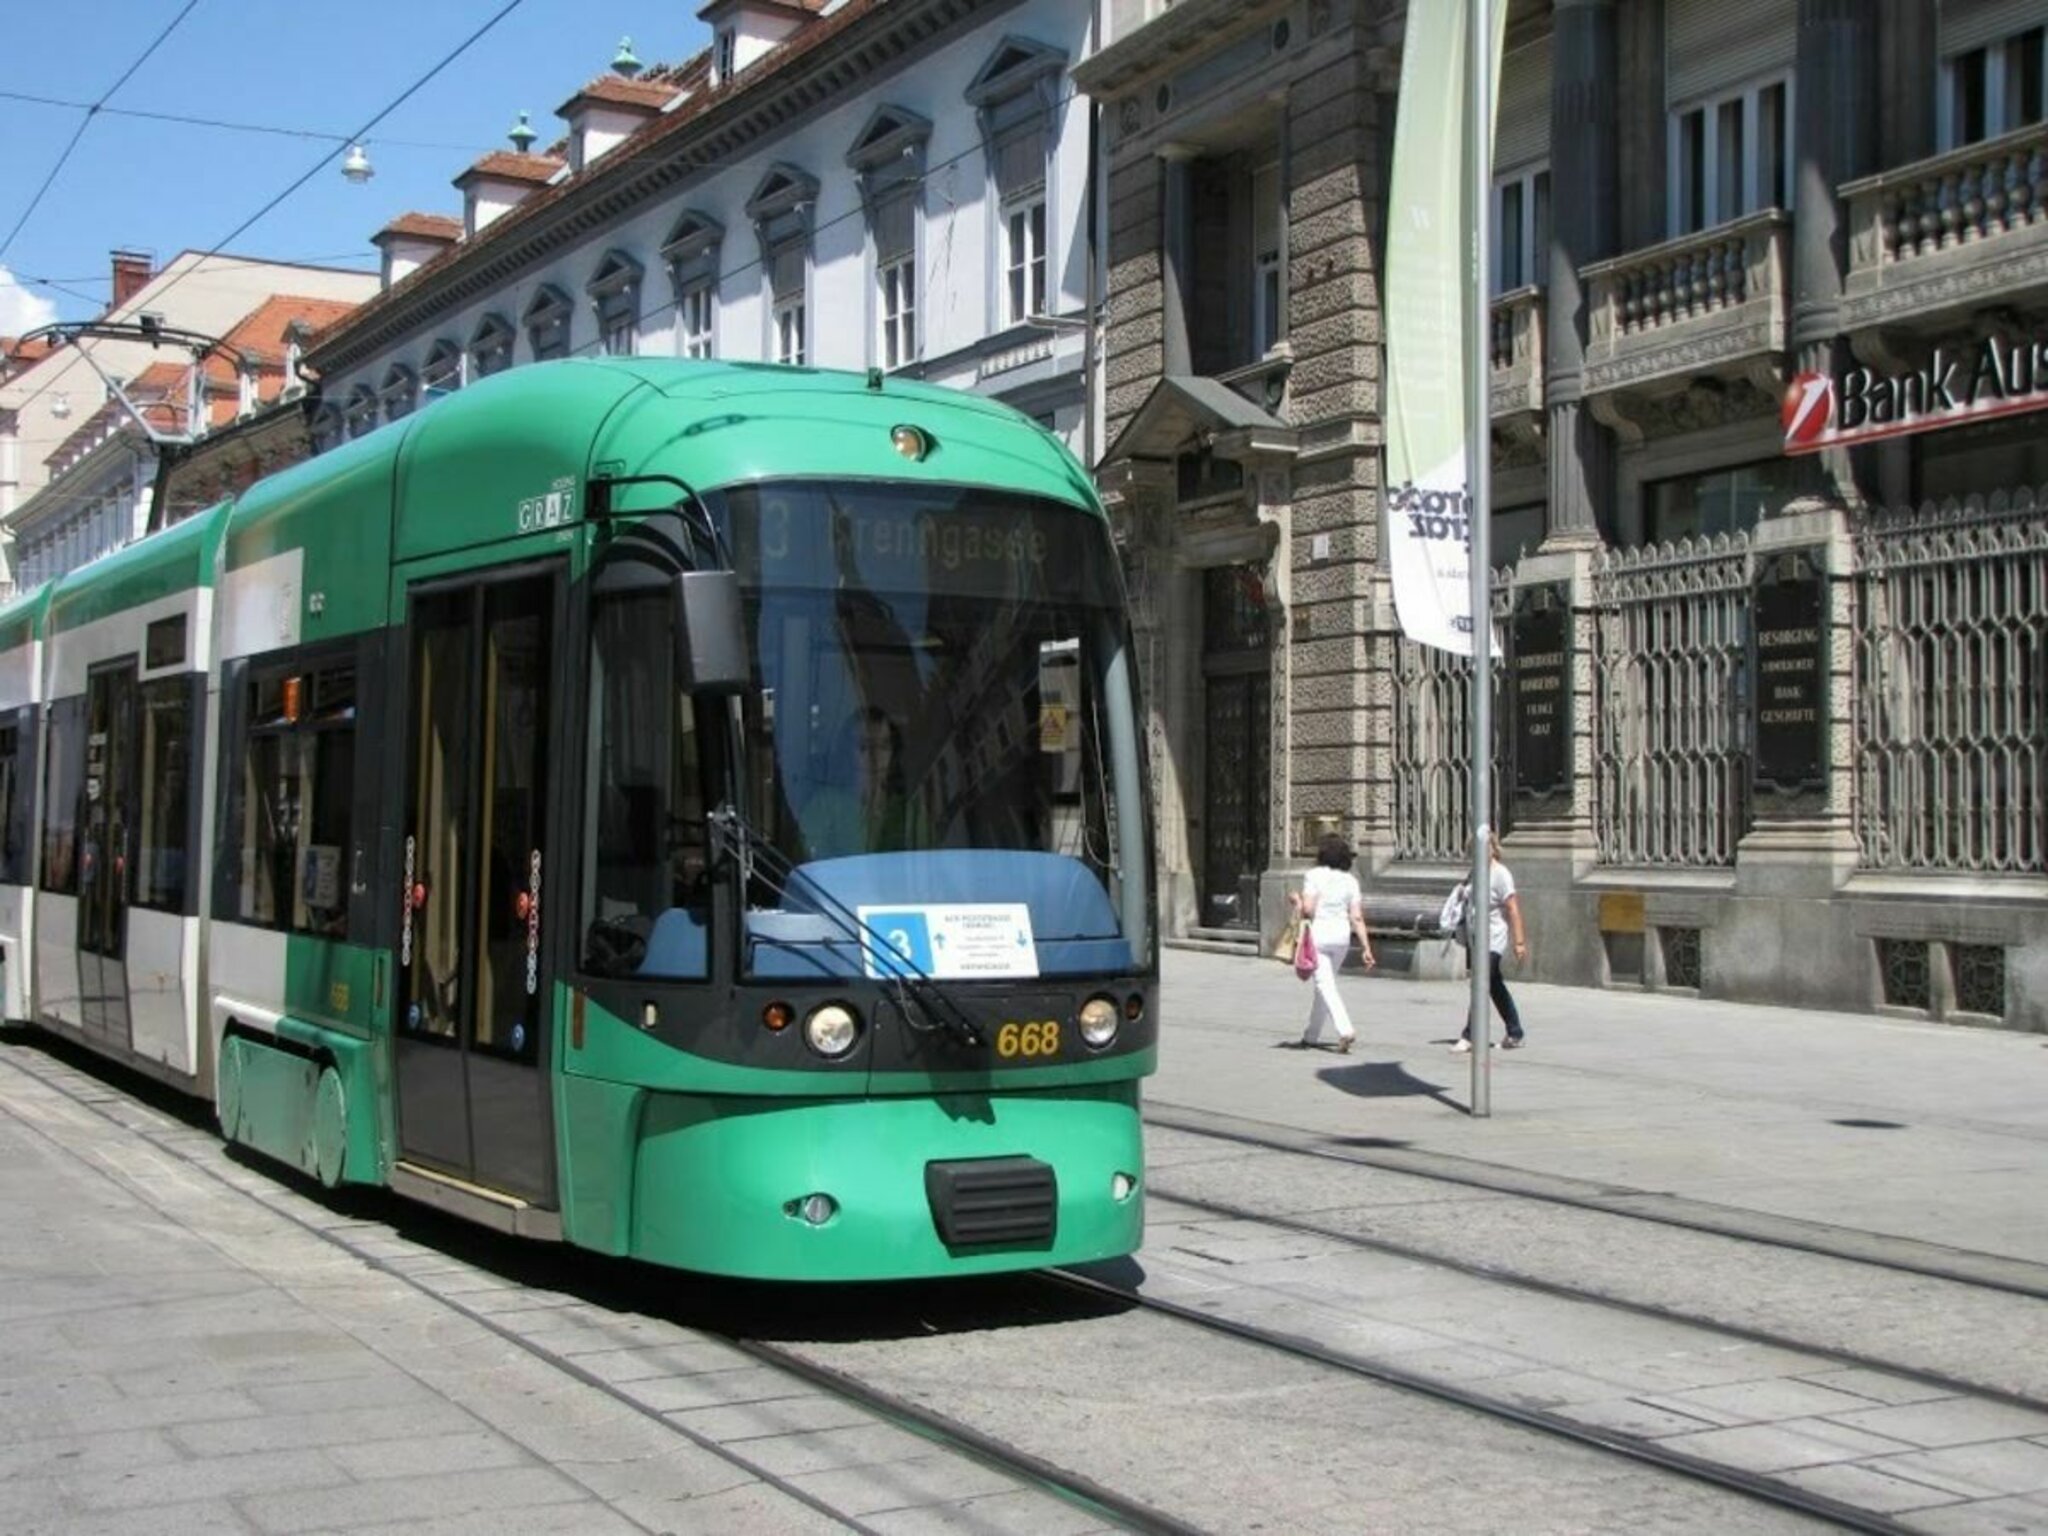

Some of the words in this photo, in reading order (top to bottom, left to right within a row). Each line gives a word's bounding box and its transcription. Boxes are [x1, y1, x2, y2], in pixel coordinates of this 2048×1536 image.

[1837, 349, 1957, 429] Bank
[517, 490, 575, 533] GRAZ
[764, 501, 790, 559] 3
[887, 928, 913, 963] 3
[996, 1020, 1060, 1058] 668
